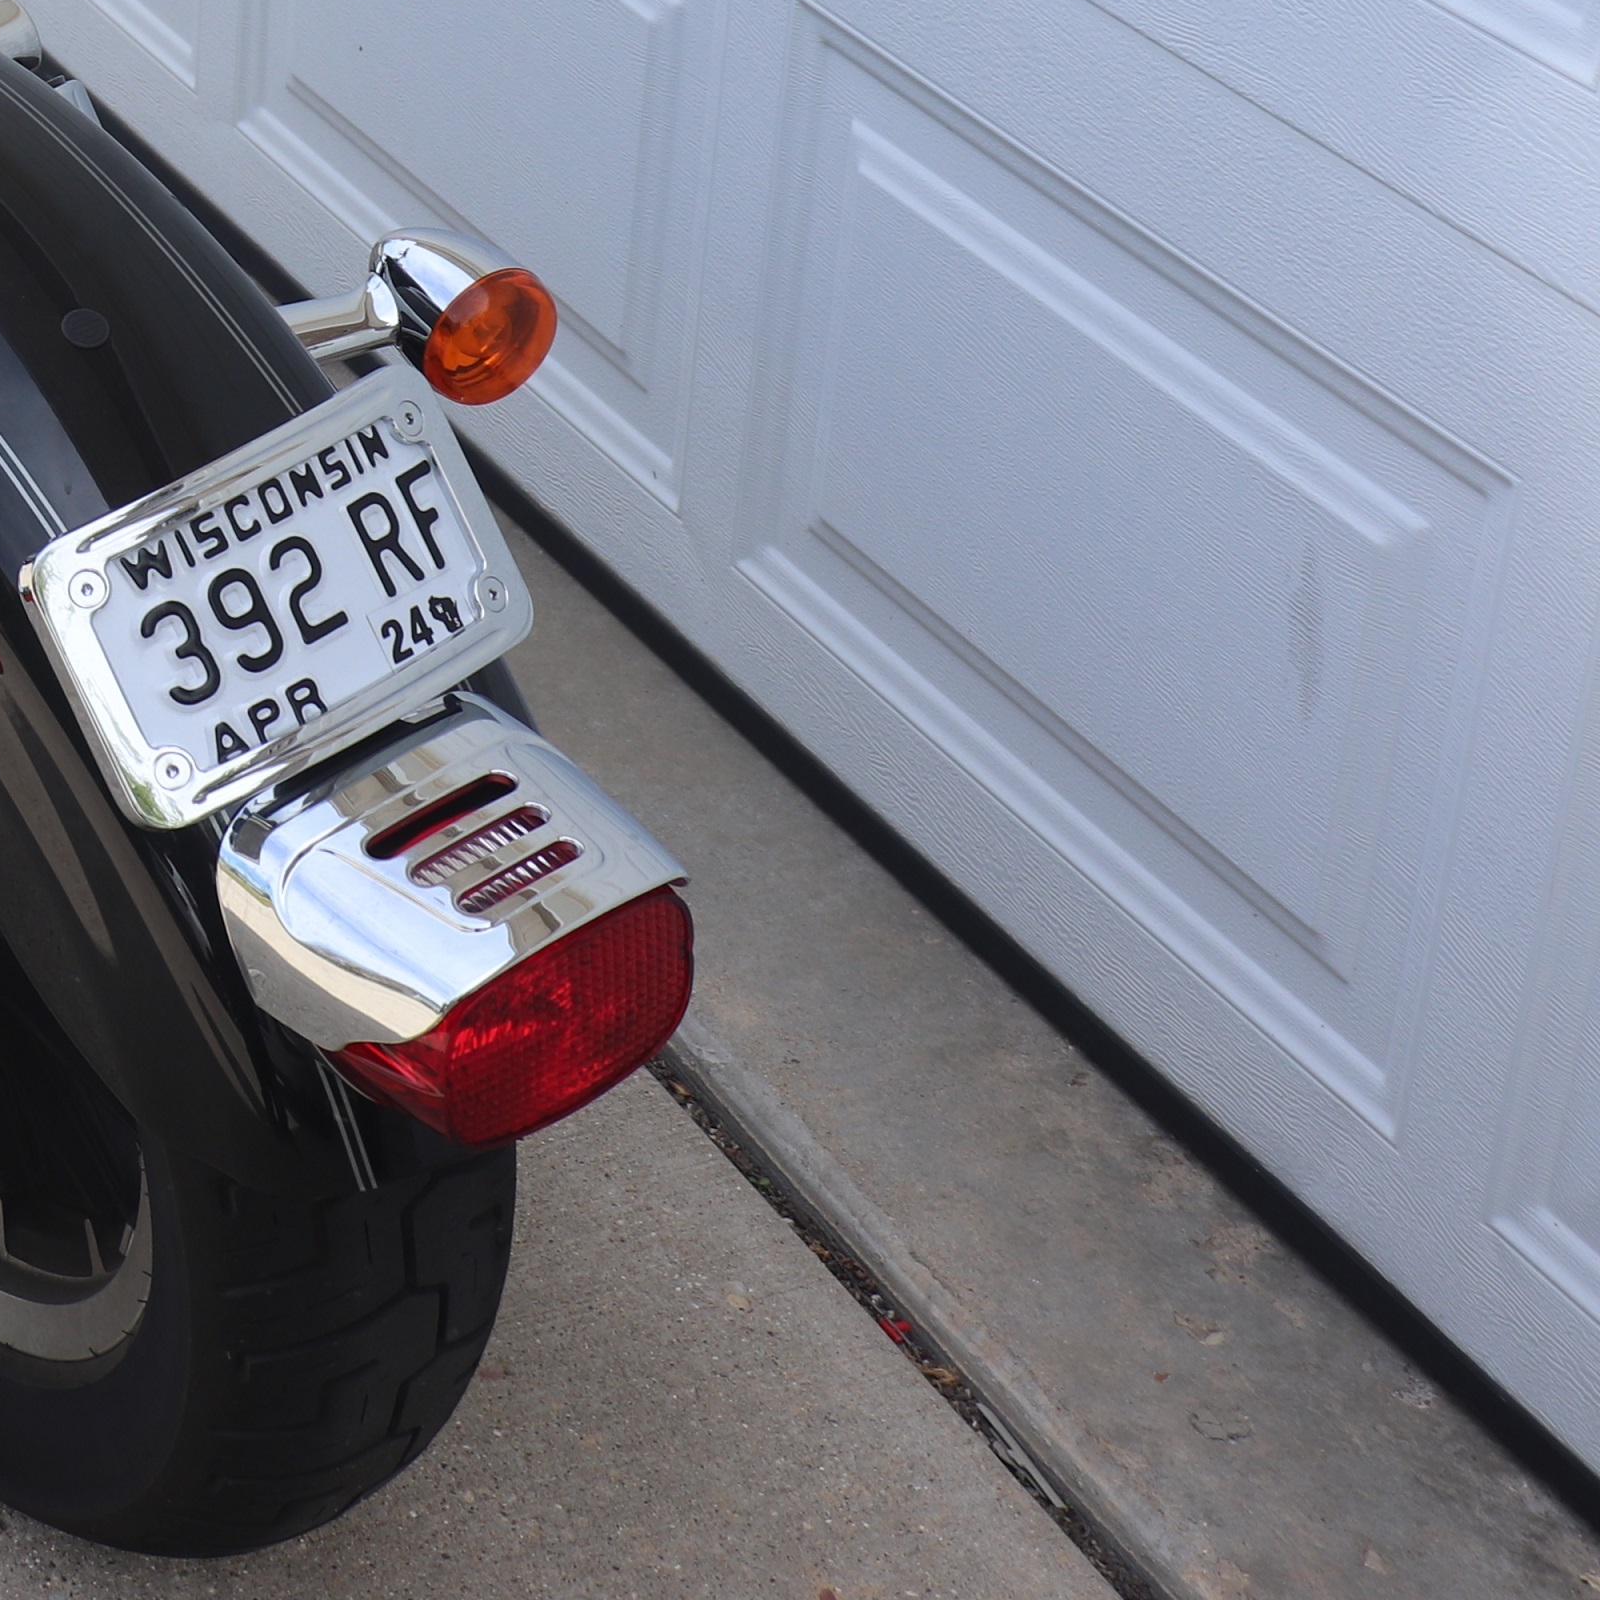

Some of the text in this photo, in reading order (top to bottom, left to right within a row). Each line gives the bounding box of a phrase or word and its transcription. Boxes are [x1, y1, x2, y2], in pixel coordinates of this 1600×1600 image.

[120, 424, 390, 590] WISCONSIN
[140, 459, 445, 705] 392 RF
[380, 606, 434, 665] 24
[213, 678, 328, 765] APR
